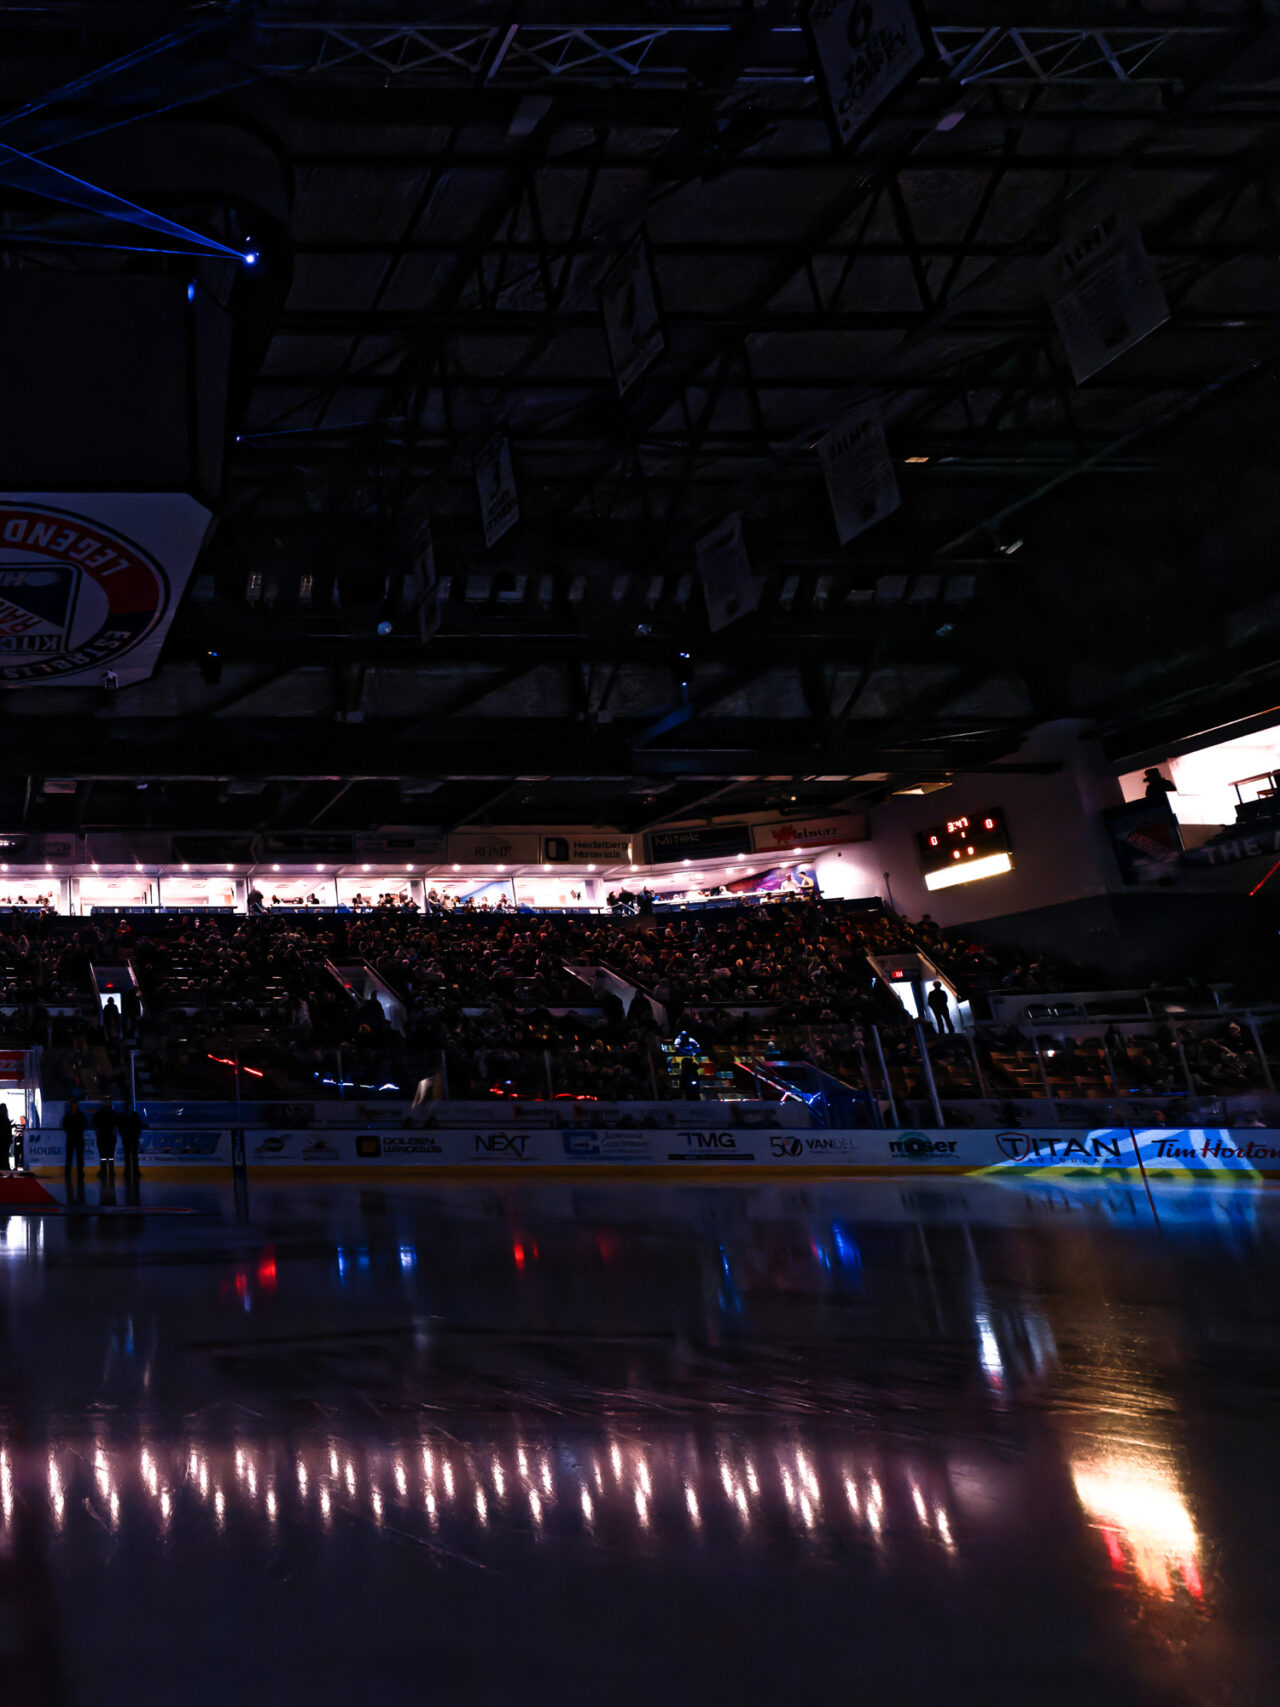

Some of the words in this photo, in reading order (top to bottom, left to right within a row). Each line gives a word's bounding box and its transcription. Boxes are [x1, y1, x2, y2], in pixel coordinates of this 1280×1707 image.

[1, 516, 131, 578] LEGEND
[947, 817, 969, 833] 3:47
[573, 841, 628, 850] Heidelberg
[1204, 836, 1262, 865] THE
[475, 1132, 530, 1157] NEXT
[677, 1133, 736, 1148] TMG
[888, 1141, 957, 1153] moser
[1002, 1137, 1121, 1157] TITAN
[1151, 1139, 1196, 1158] Tim
